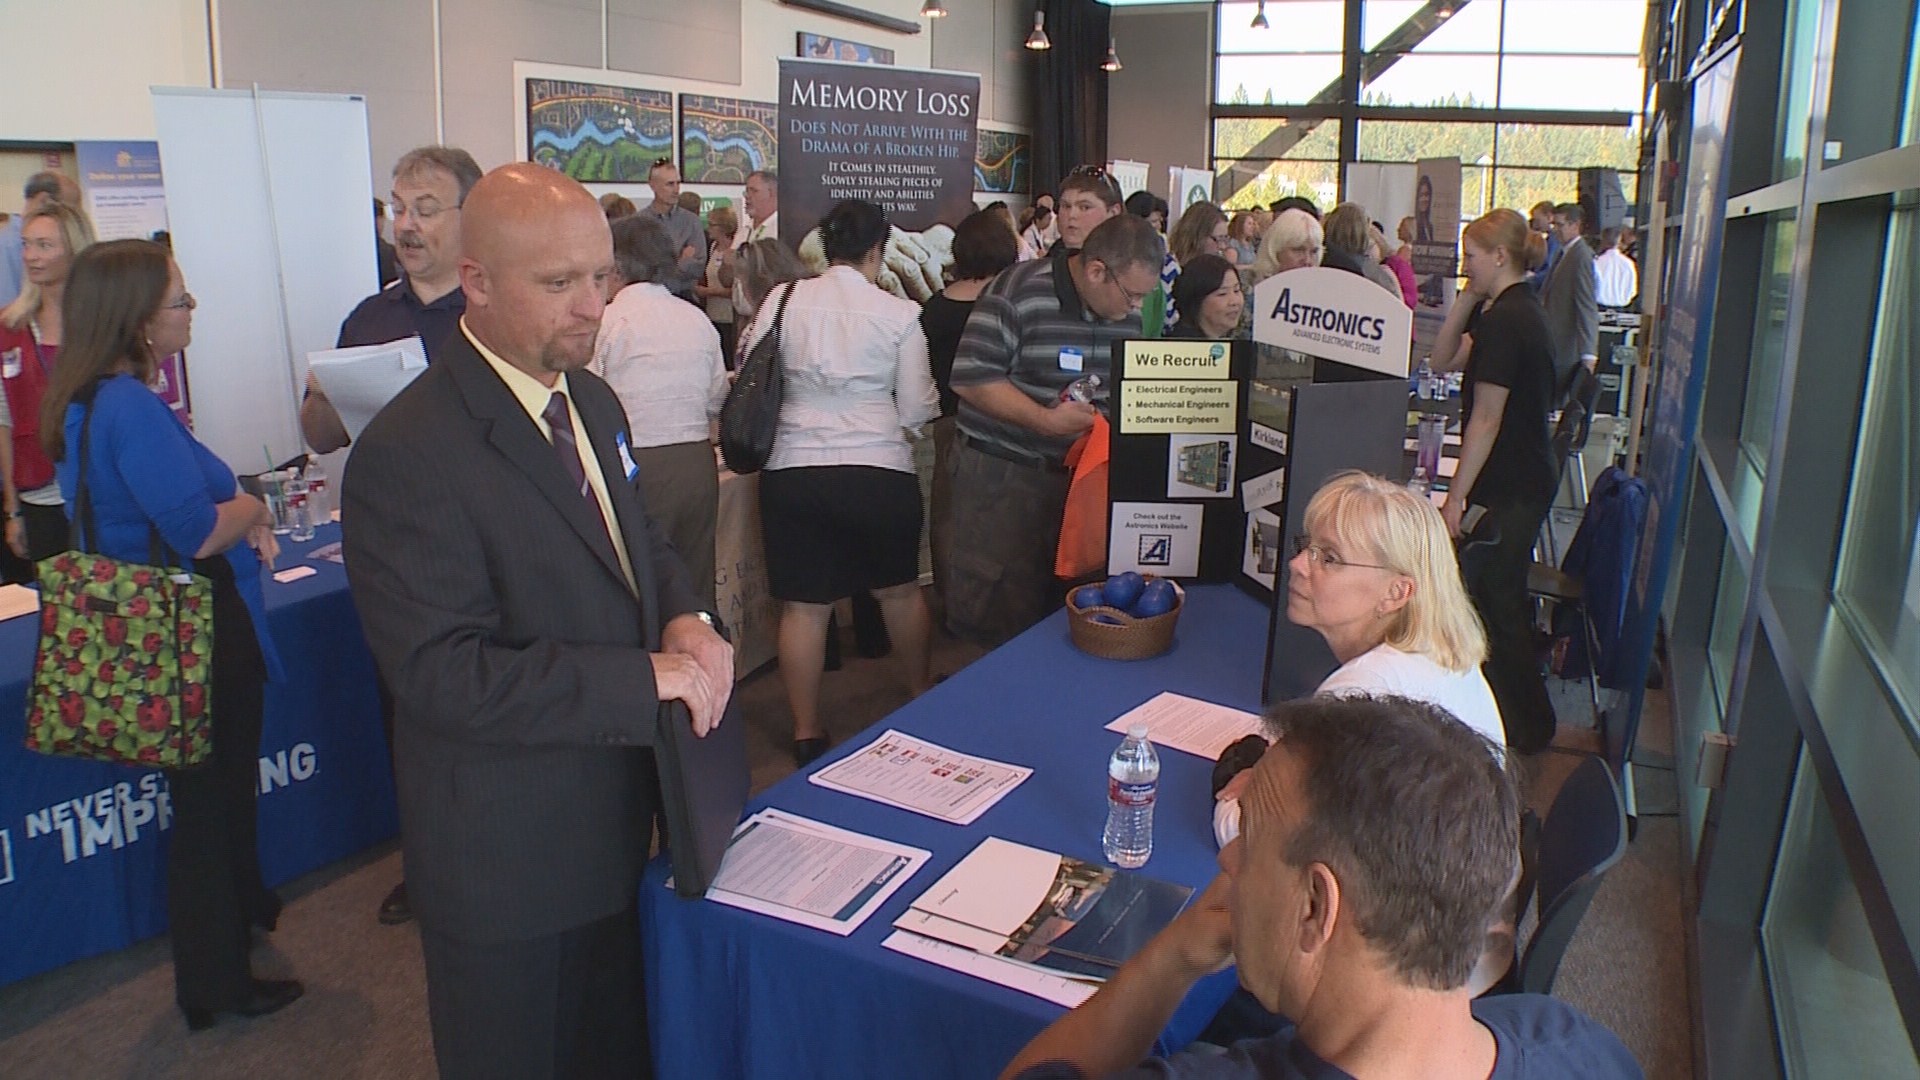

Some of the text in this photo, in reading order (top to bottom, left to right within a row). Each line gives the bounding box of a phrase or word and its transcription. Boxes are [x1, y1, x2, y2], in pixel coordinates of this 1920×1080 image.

[790, 77, 971, 118] MEMORY LOSS
[790, 118, 969, 142] DOES NOT ARRIVE WITH THE
[801, 137, 850, 154] DRAMA
[853, 142, 870, 155] OF
[873, 143, 883, 155] A
[885, 141, 934, 157] BROKEN
[828, 161, 839, 172] IT
[840, 161, 873, 173] COMES
[874, 163, 886, 174] IN
[821, 174, 944, 188] SLOWLY STEALING PIECES OF
[830, 188, 935, 200] IDENTITY AND ABILITIES
[1270, 287, 1386, 341] ASTRONICS
[1292, 328, 1382, 355] ADVANCED ELECTRONIC SYSTEMS
[1135, 353, 1219, 368] We Recruit
[1135, 385, 1223, 396] Electrical Engineers
[1135, 400, 1231, 410] Mechanical Engineers
[1135, 415, 1220, 425] Software Engineers
[1133, 512, 1182, 521] Check out the
[25, 781, 132, 839] NEVER
